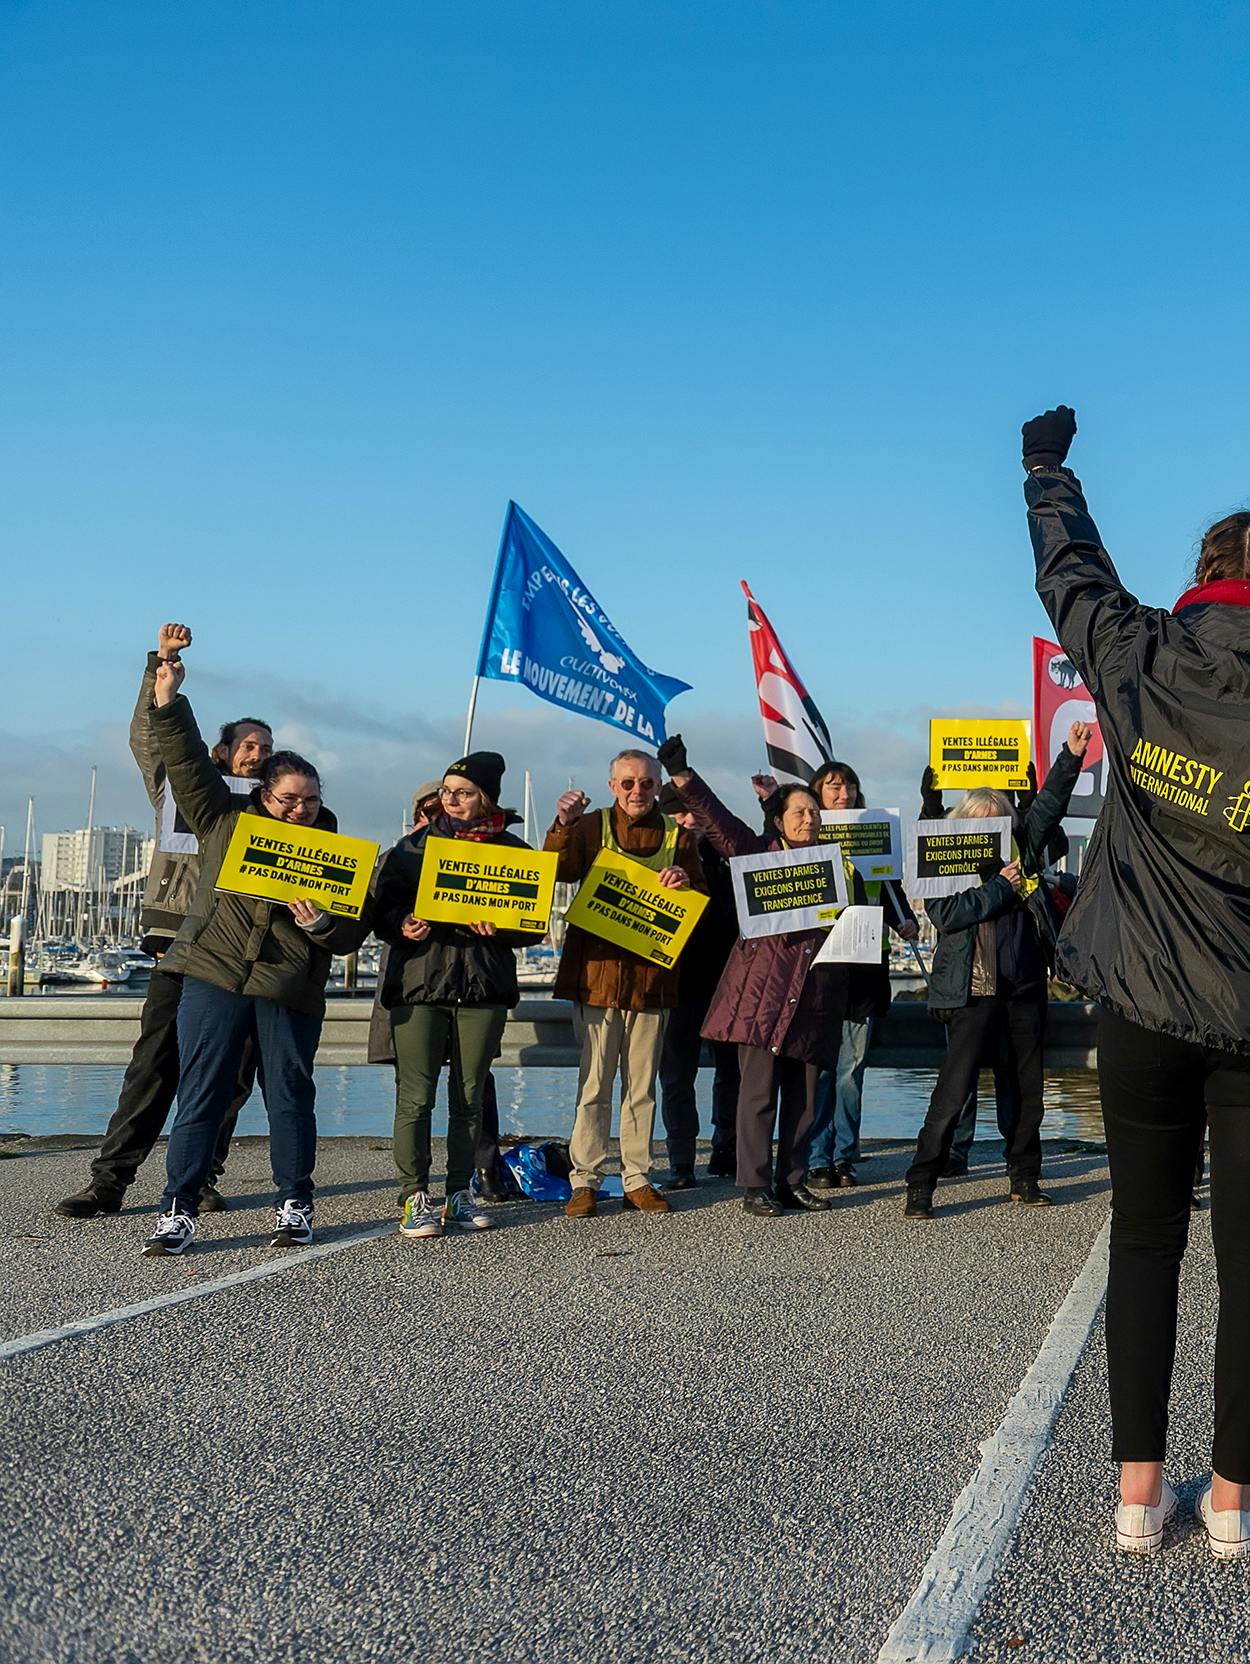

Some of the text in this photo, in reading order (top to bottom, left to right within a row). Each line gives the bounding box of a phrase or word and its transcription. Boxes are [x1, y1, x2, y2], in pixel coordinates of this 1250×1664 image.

[500, 648, 654, 740] LE MOUVEMENT DE LA
[942, 735, 1019, 747] VENTES ILLÉGALES
[963, 750, 998, 760] D'ARMES
[963, 764, 982, 772] DANS
[983, 764, 1000, 772] MON
[1000, 764, 1019, 772] PORT
[1130, 737, 1224, 795] AMNESTY
[1130, 765, 1209, 816] NTERNATIONAL
[926, 837, 955, 847] VENTES
[956, 834, 989, 846] D'ARMES
[250, 834, 358, 869] VENTES ILLÉGALES
[925, 848, 994, 862] EXIGEONS PLUS DE
[276, 856, 325, 877] D'ARMES
[439, 858, 540, 881] VENTES ILLÉGALES
[752, 869, 783, 883] VENTES
[785, 864, 820, 879] D'ARMES
[938, 861, 980, 875] CONTRÔLE
[270, 870, 297, 884] DANS
[299, 877, 323, 891] MON
[323, 883, 352, 897] PORT
[465, 878, 511, 894] D'ARMES
[754, 877, 828, 898] EXIGEONS PLUS DE
[462, 894, 487, 907] DANS
[488, 897, 510, 909] MON
[511, 900, 537, 912] PORT
[602, 871, 687, 919] VENTES ILLÉGALES
[762, 892, 824, 912] TRANSPARENCE
[618, 897, 657, 922] D'ARMES
[610, 908, 633, 928] DANS
[631, 918, 653, 937] MON
[650, 928, 674, 946] PORT
